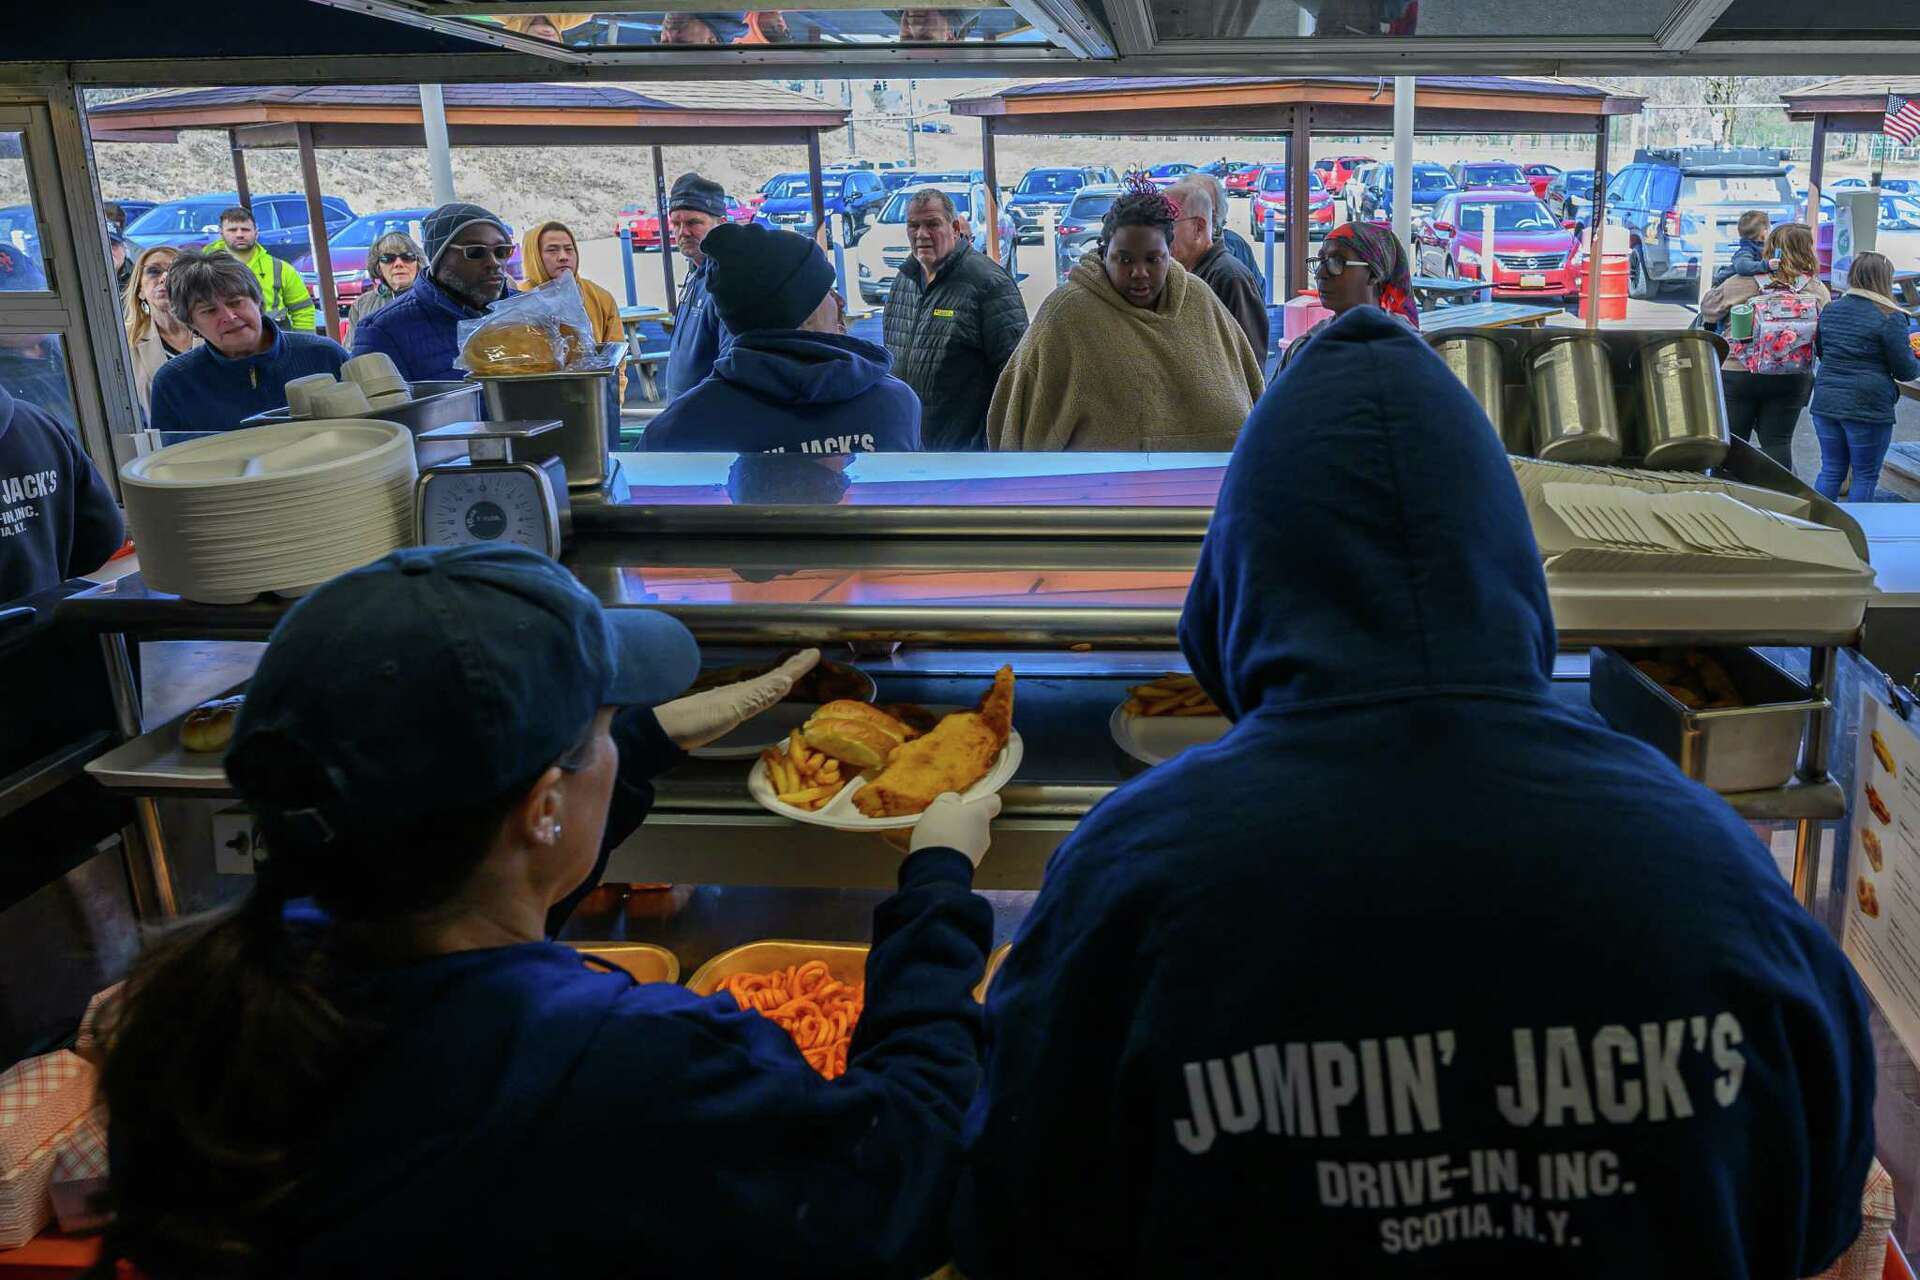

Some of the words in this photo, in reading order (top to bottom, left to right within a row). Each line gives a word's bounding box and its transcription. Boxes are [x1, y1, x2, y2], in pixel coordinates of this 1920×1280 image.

[2, 470, 57, 504] JACK'S
[1173, 1029, 1456, 1155] JUMPIN'
[1495, 1011, 1746, 1127] JACK'S
[1537, 1149, 1637, 1200] INC.
[1379, 1203, 1505, 1254] SCOTIA,
[1513, 1203, 1583, 1247] N.Y.
